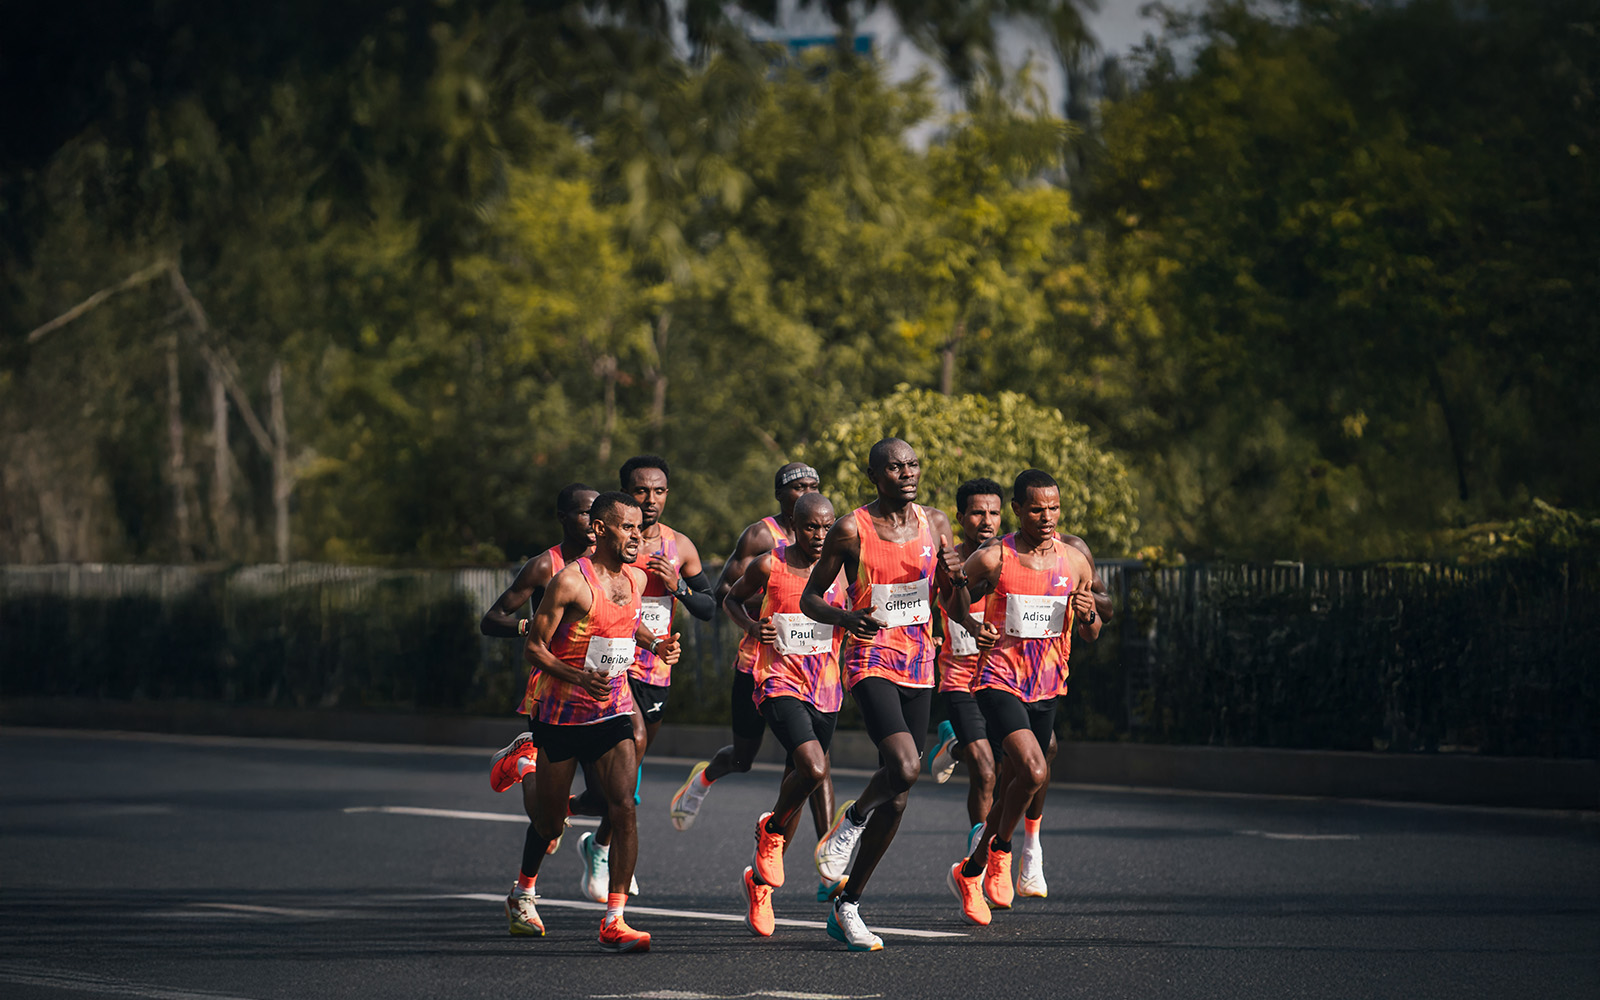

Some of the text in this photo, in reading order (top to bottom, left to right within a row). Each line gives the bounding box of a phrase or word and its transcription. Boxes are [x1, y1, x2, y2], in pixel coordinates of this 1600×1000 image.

[885, 598, 921, 611] Gilbert
[1022, 612, 1051, 621] Adisu
[790, 629, 814, 639] Paul
[601, 654, 629, 664] Deribe
